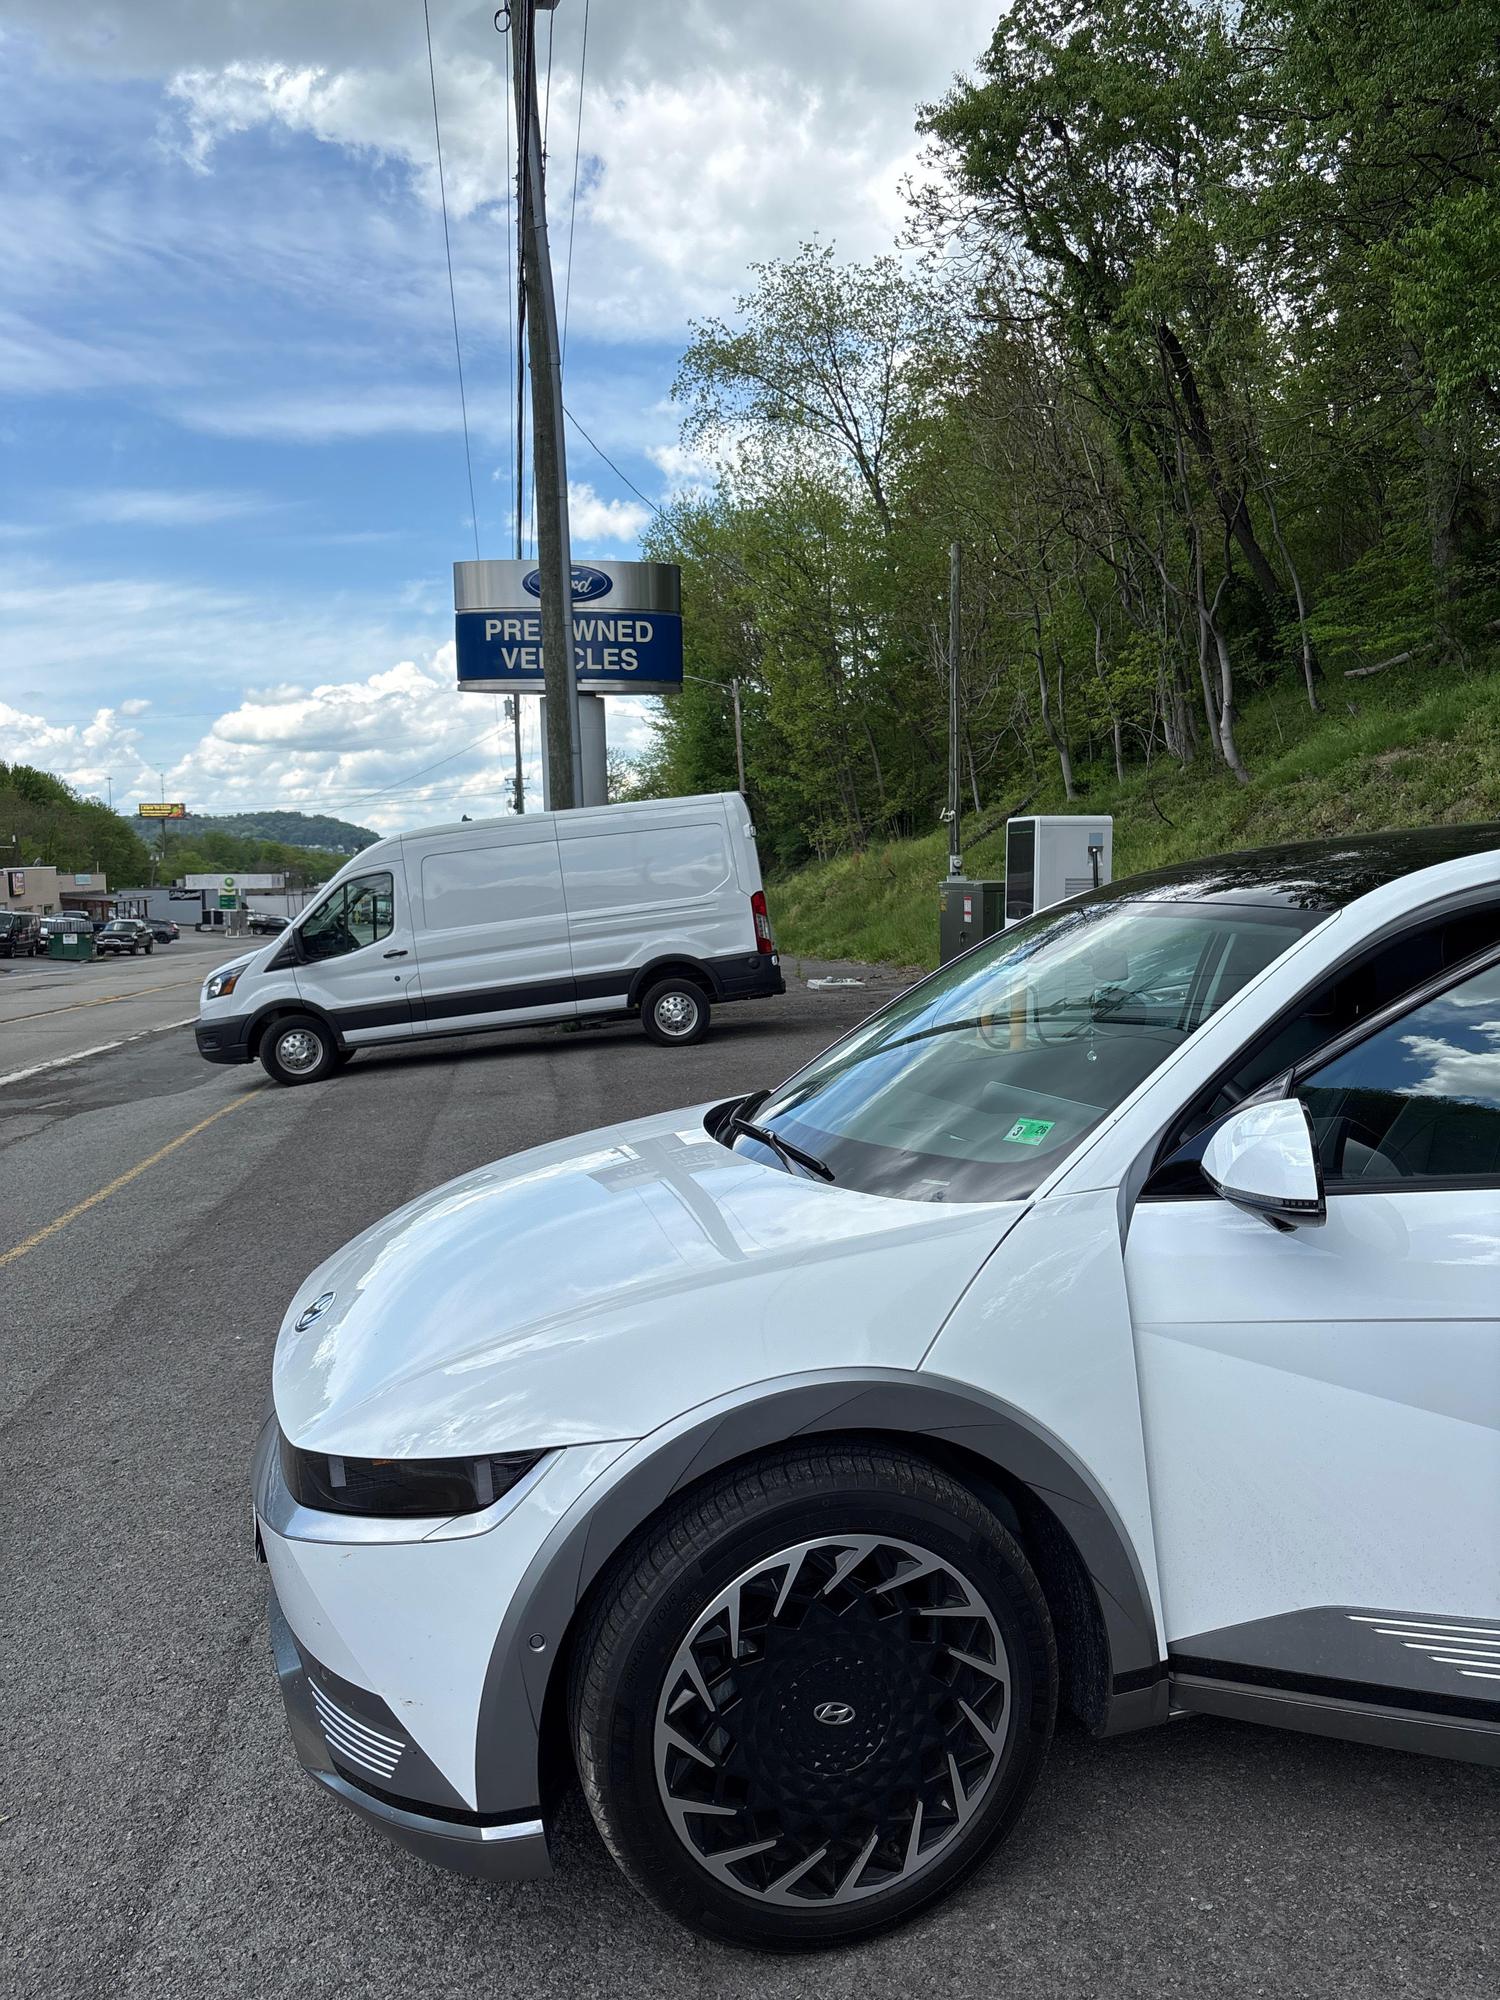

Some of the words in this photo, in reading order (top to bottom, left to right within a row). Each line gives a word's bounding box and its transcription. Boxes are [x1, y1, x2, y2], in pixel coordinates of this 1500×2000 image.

[485, 619, 654, 643] PREWNED
[501, 647, 639, 671] VECLES
[1012, 1126, 1024, 1137] 3
[1035, 1125, 1049, 1135] 26
[623, 1631, 653, 1689] PRIMACY
[651, 1592, 678, 1628] TOUR
